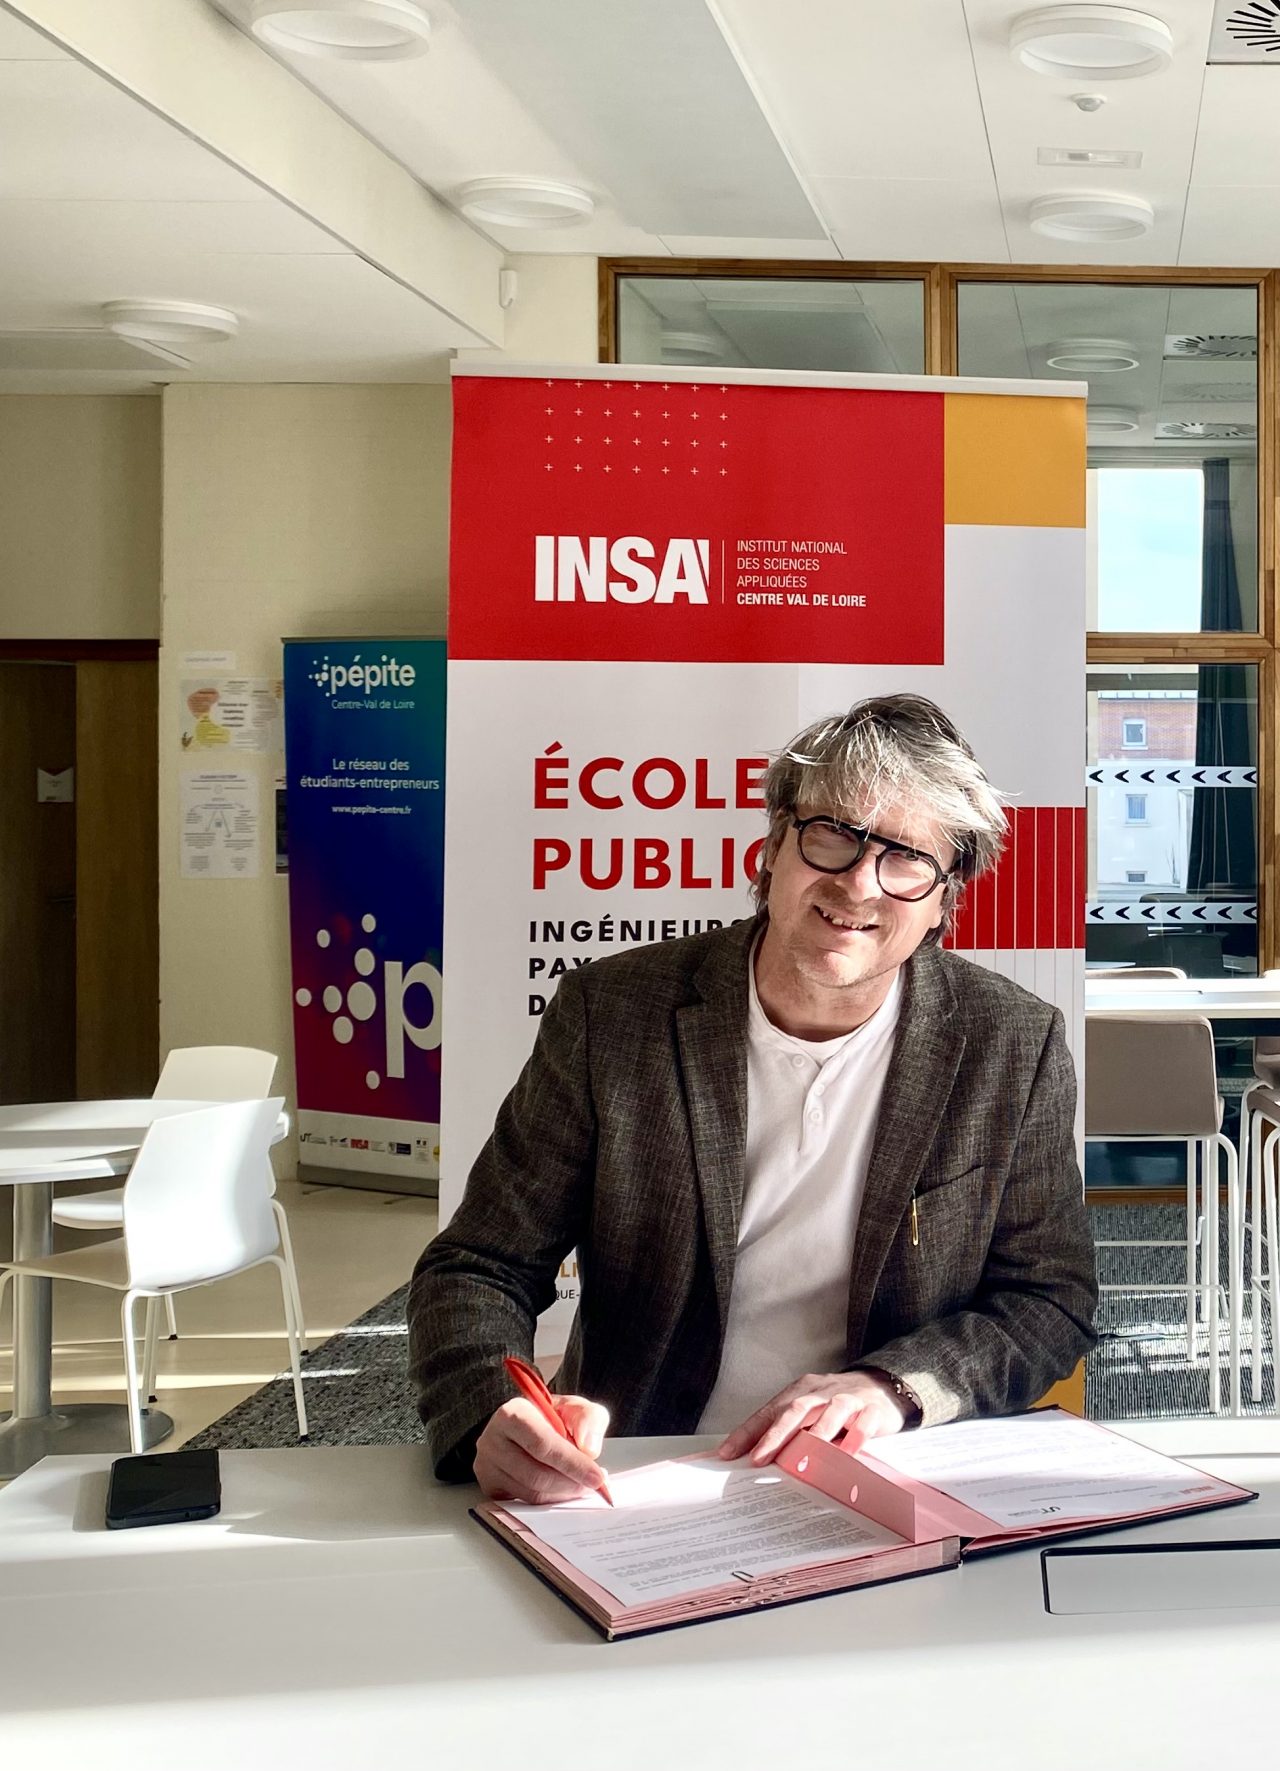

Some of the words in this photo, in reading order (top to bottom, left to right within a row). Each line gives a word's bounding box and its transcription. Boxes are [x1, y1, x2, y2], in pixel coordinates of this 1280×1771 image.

[736, 540, 787, 553] INSTITUT
[791, 541, 848, 555] NATIONAL
[535, 536, 710, 605] INSA
[736, 557, 760, 570] DES
[763, 558, 820, 571] SCIENCES
[736, 574, 807, 588] APPLIQUÉES
[736, 593, 784, 605] CENTRE
[787, 593, 809, 606] VAL
[812, 594, 829, 606] DE
[832, 595, 867, 607] LOIRE
[330, 654, 416, 694] pépite
[331, 699, 377, 709] Centre-Val
[380, 699, 391, 709] de
[393, 699, 415, 709] Loire
[332, 758, 345, 770] Le
[349, 758, 386, 770] réseau
[389, 758, 410, 771] des
[534, 740, 770, 810] ÉCOLE
[300, 775, 439, 791] étudiants-entrepreneurs
